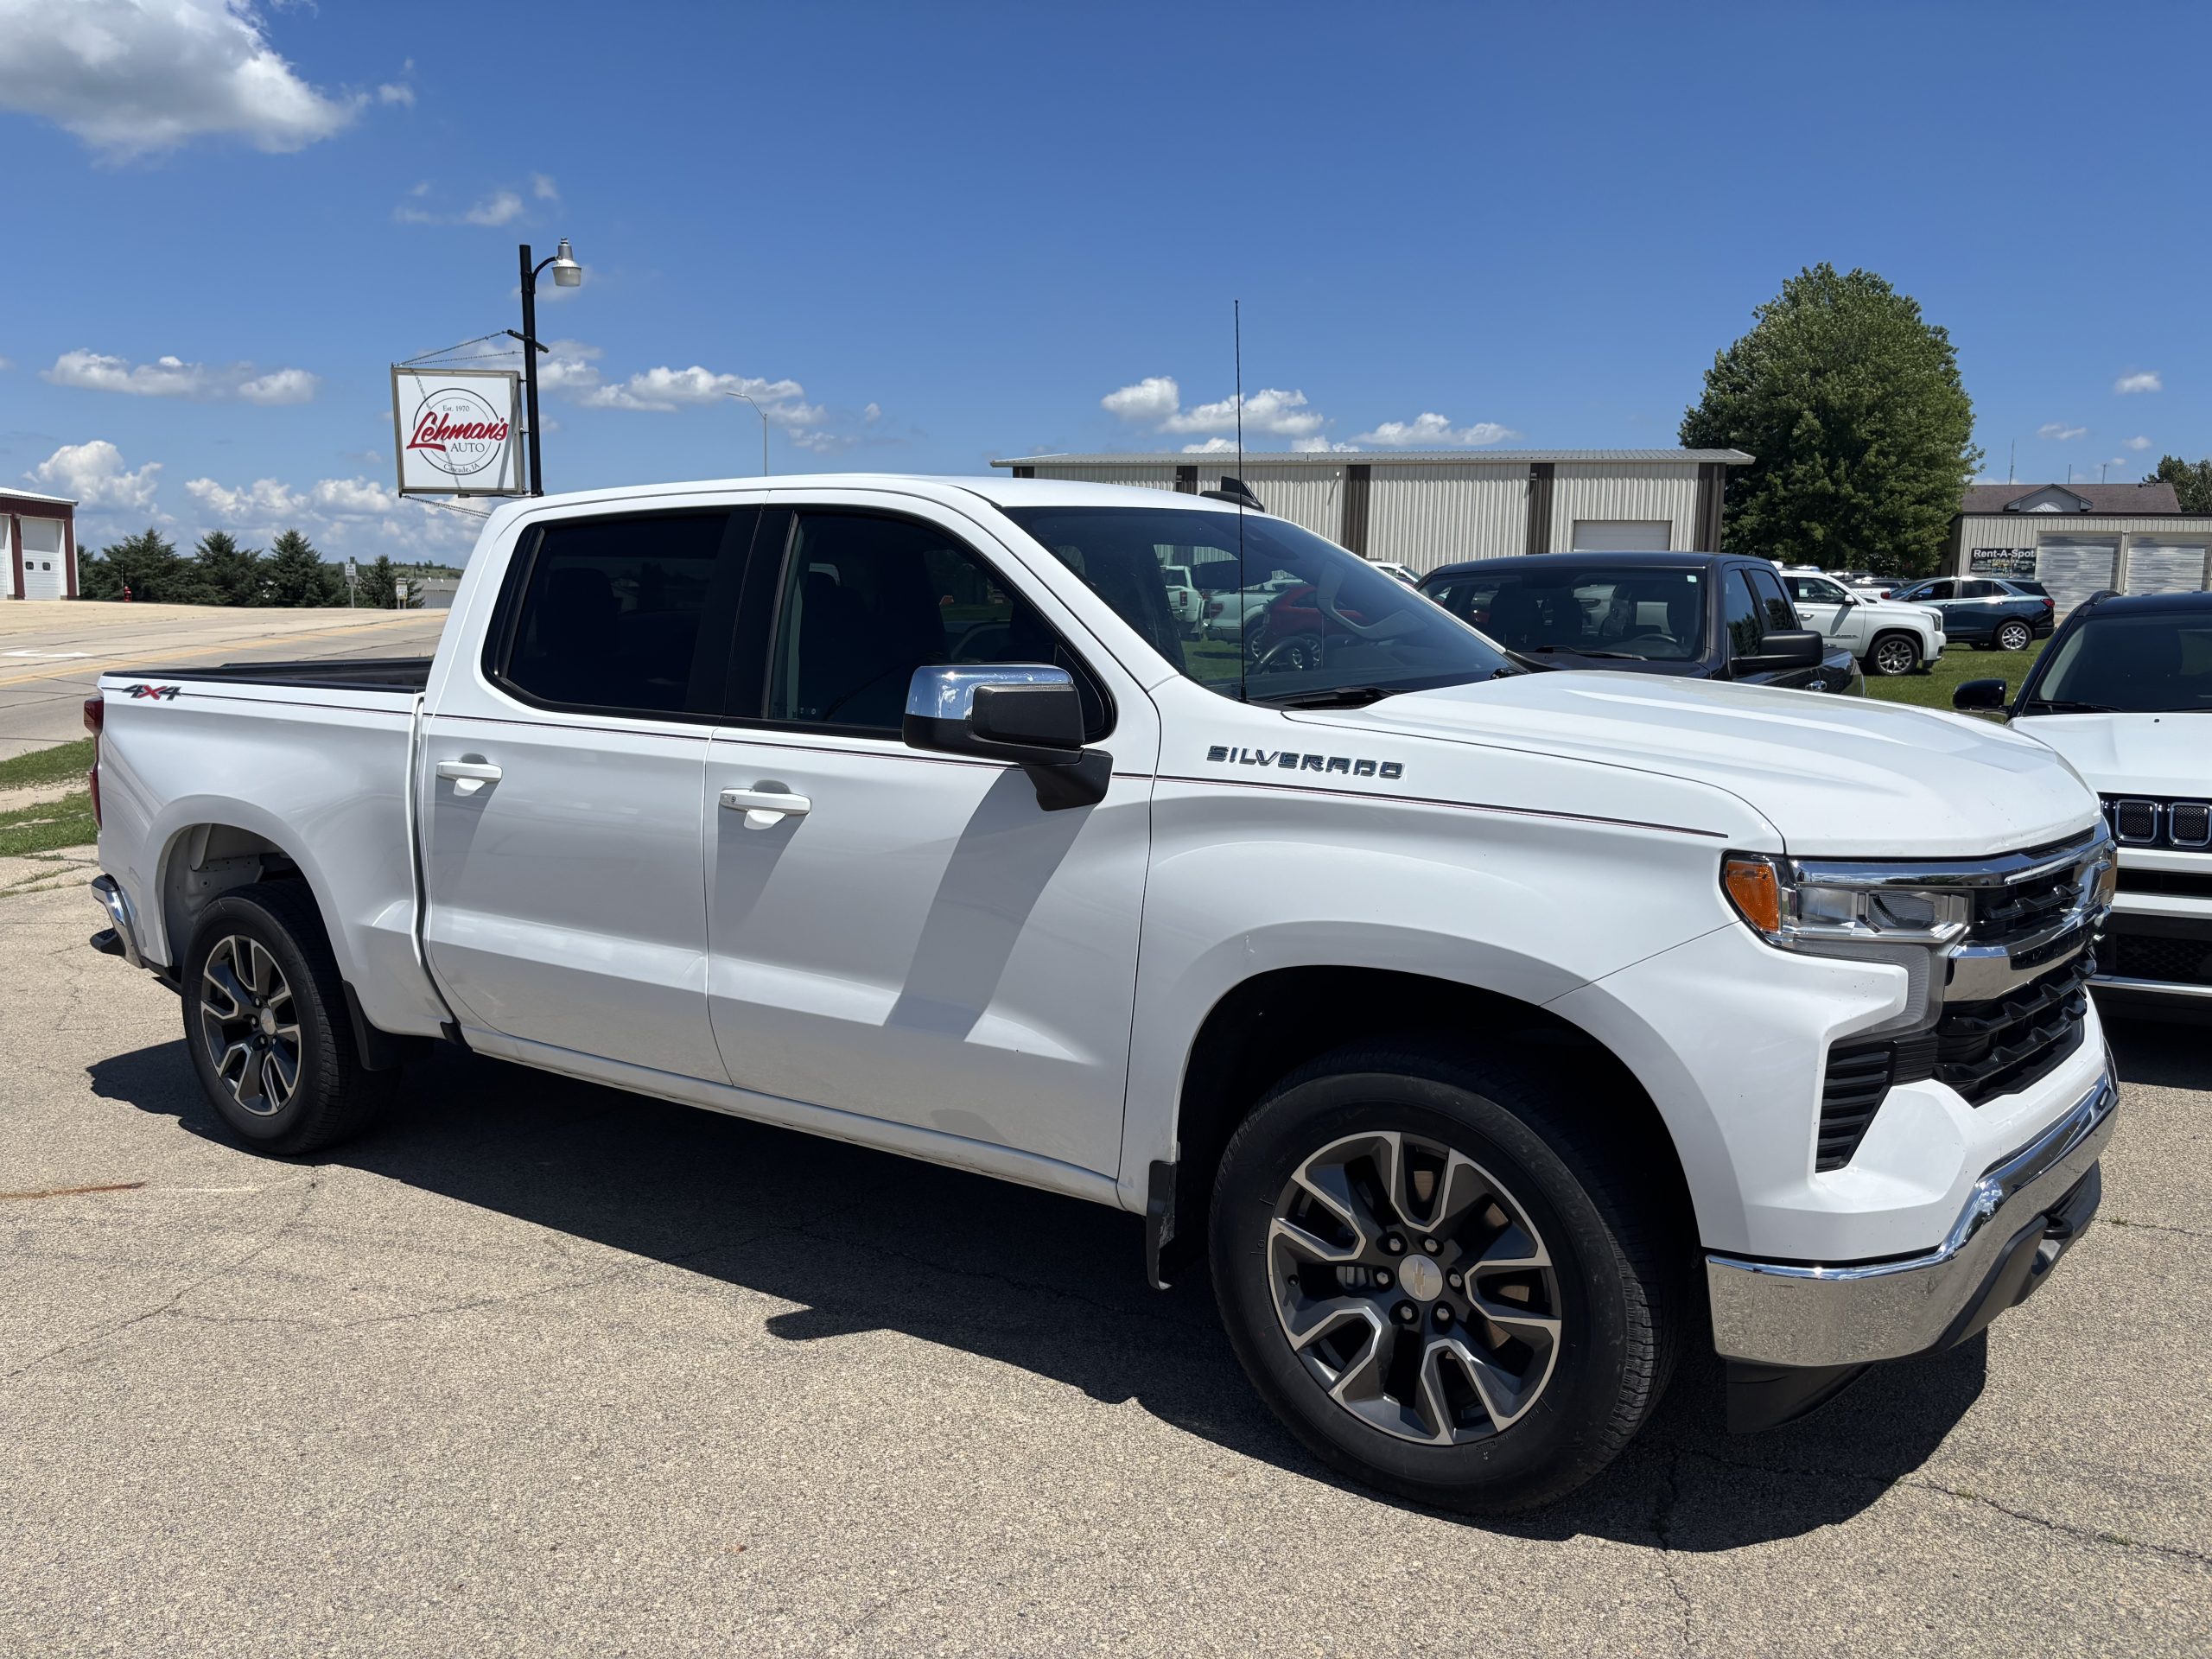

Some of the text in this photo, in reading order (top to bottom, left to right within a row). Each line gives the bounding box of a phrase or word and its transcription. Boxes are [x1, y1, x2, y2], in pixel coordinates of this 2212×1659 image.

[406, 411, 509, 452] Lehman's
[450, 442, 486, 453] AUTO
[471, 462, 480, 471] IA
[1974, 549, 2035, 559] Rent-A-Spot
[1206, 745, 1405, 779] SILVERADO
